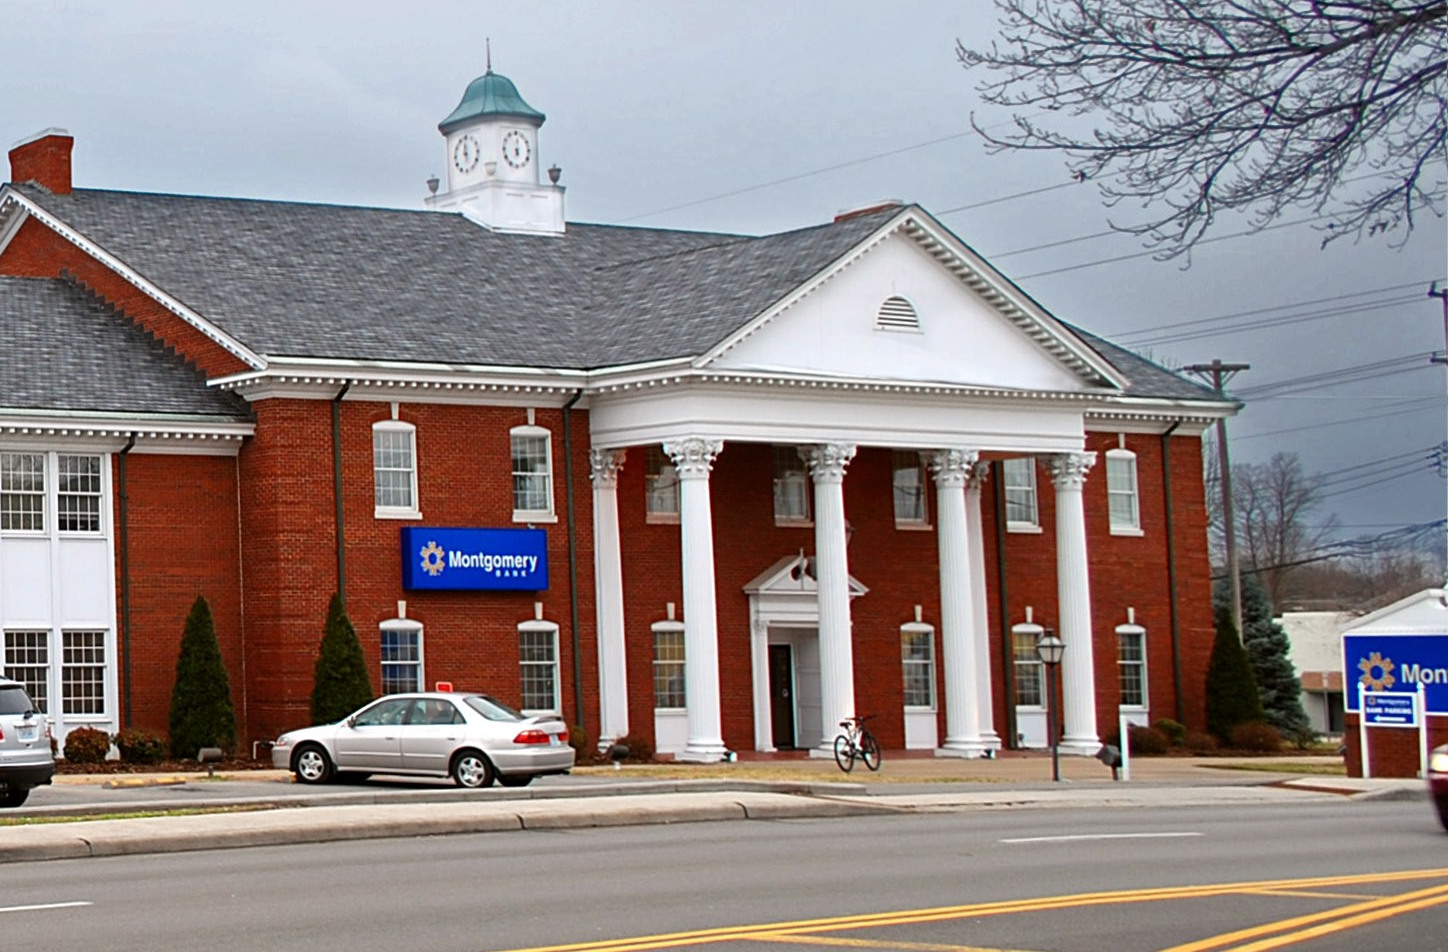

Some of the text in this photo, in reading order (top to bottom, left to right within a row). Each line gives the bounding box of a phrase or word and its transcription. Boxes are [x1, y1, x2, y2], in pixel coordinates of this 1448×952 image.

[449, 551, 537, 572] Montgomery
[495, 569, 527, 577] BANK
[1401, 664, 1448, 684] Mon
